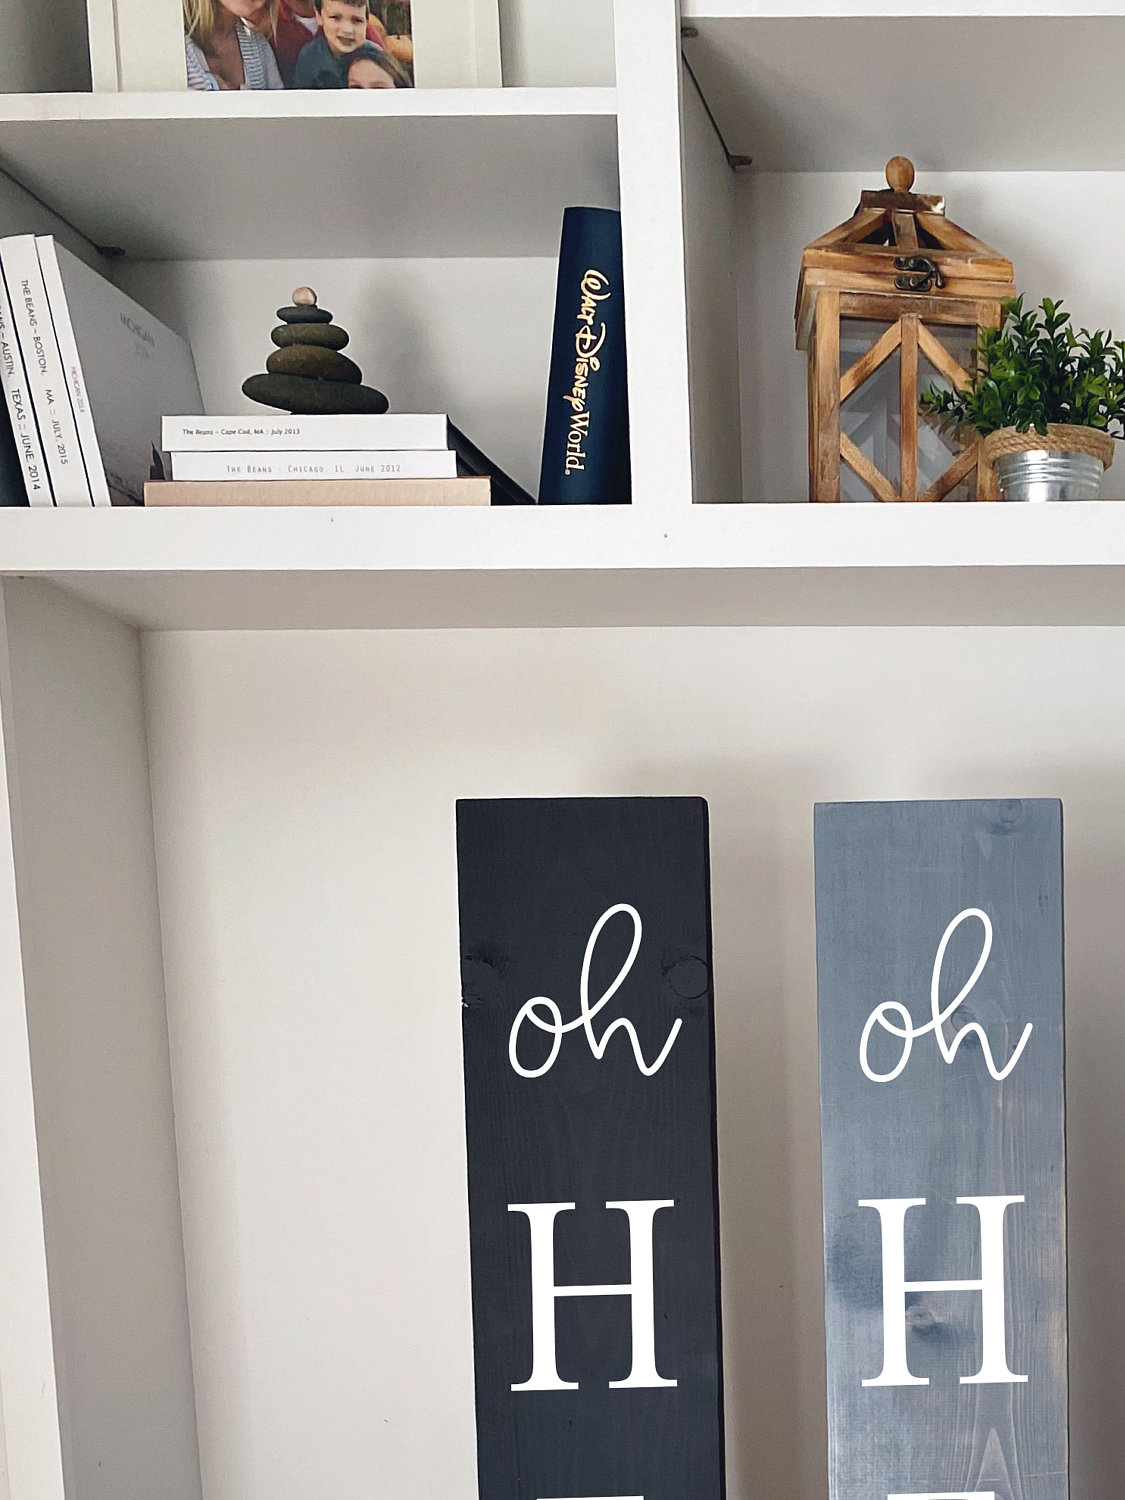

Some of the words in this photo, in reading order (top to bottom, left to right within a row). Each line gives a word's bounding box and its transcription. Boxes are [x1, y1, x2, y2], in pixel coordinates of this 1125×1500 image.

[21, 279, 32, 295] THE
[25, 297, 38, 327] BEANS
[44, 388, 55, 405] MA
[11, 388, 26, 421] TEXAS
[28, 465, 42, 490] 2014
[195, 428, 214, 436] Beans
[220, 428, 237, 437] Cape
[270, 428, 282, 437] July
[57, 444, 69, 465] 2015
[380, 464, 402, 473] 2012
[508, 903, 682, 1078] oh
[859, 907, 1032, 1083] oh
